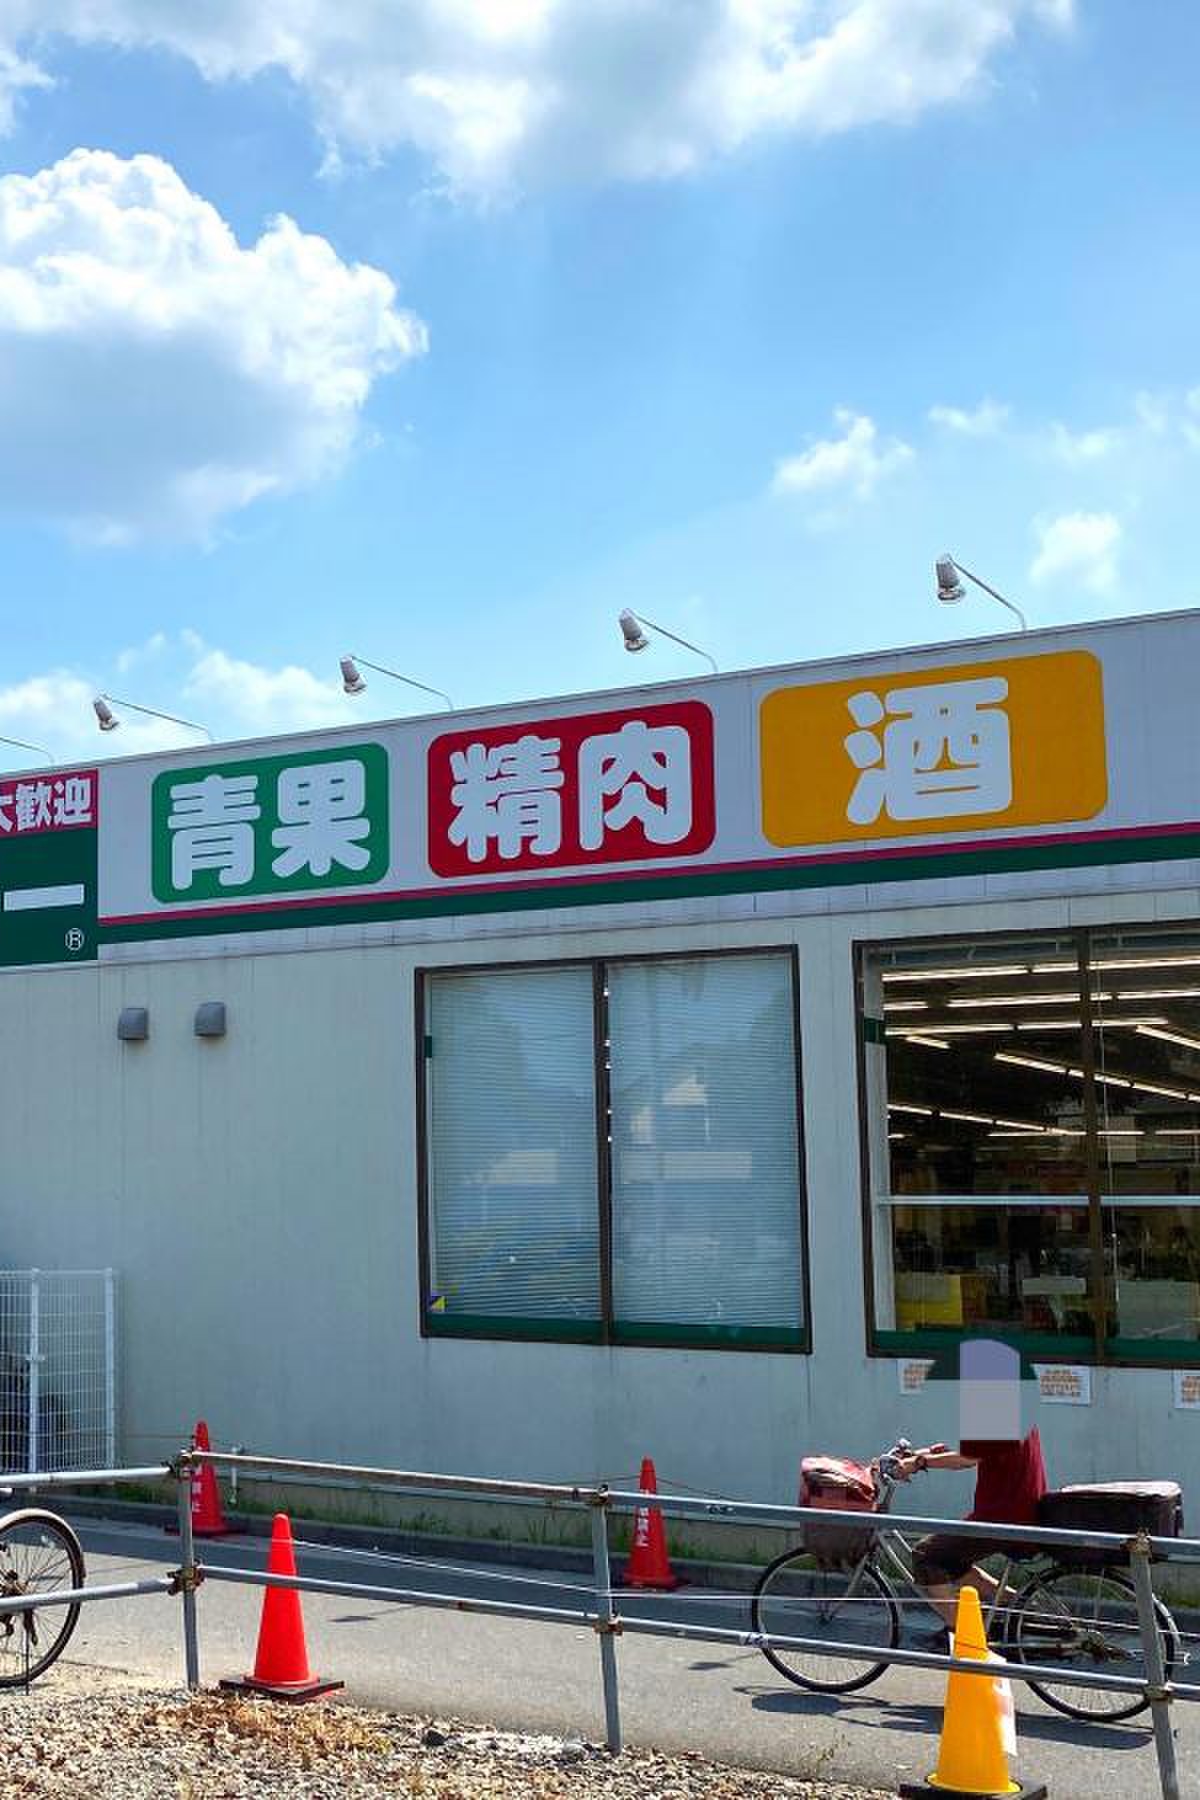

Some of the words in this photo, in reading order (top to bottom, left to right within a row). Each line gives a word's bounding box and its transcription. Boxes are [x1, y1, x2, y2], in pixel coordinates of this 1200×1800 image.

[447, 719, 694, 862] 精肉
[845, 676, 1013, 826] 酒
[166, 759, 372, 889] 青果
